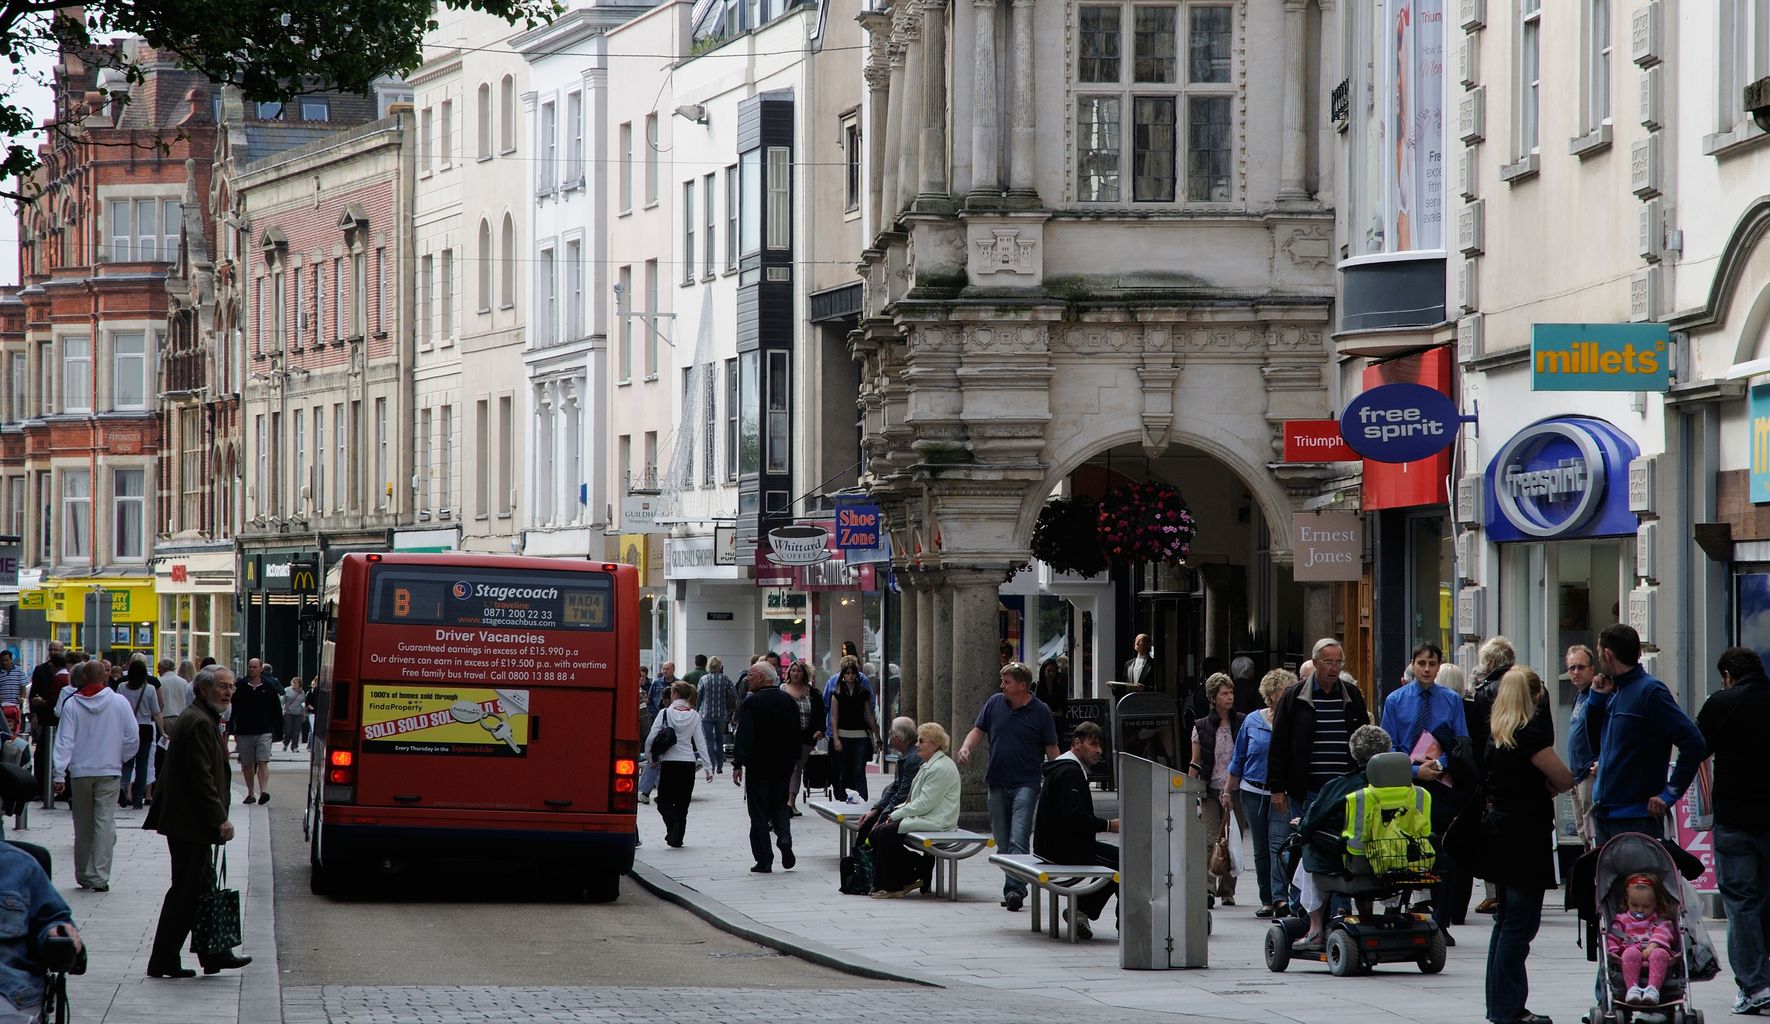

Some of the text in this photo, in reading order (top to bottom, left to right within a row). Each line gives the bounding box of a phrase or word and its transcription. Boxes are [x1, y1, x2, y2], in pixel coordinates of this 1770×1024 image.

[1421, 12, 1442, 25] Trium
[1429, 151, 1442, 163] Fre
[1535, 342, 1659, 375] millets
[1359, 406, 1421, 423] free
[1363, 419, 1444, 442] spirit
[1294, 436, 1344, 449] Triumph
[1506, 458, 1588, 503] freespirit
[839, 509, 876, 526] Shoe
[840, 528, 876, 546] Zone
[1300, 526, 1355, 542] Ernest
[774, 538, 822, 552] Whittard
[1305, 548, 1353, 568] Jones
[475, 583, 558, 601] Stagecoach
[394, 588, 411, 617] B
[484, 608, 553, 619] 0871 200 22 33
[436, 629, 545, 644] Driver Vacancies
[397, 642, 445, 653] Guaranteed
[447, 645, 482, 656] earnings
[484, 645, 491, 654] in
[493, 647, 517, 655] excess
[519, 646, 528, 655] of
[370, 653, 387, 663] Our
[389, 654, 415, 664] drivers
[434, 658, 453, 666] earn
[454, 657, 462, 666] in
[464, 659, 489, 667] excess
[491, 658, 499, 667] of
[554, 659, 571, 669] with
[572, 660, 607, 670] overtime
[402, 667, 575, 681] Free family bus travel Call 0800 13 88 88 4
[370, 691, 390, 699] 1000's
[399, 692, 419, 700] homes
[420, 692, 433, 700] sold
[434, 693, 459, 701] through
[1065, 704, 1100, 720] PREZZO
[364, 709, 456, 740] SOLD SOLD SOL
[395, 745, 410, 753] Every
